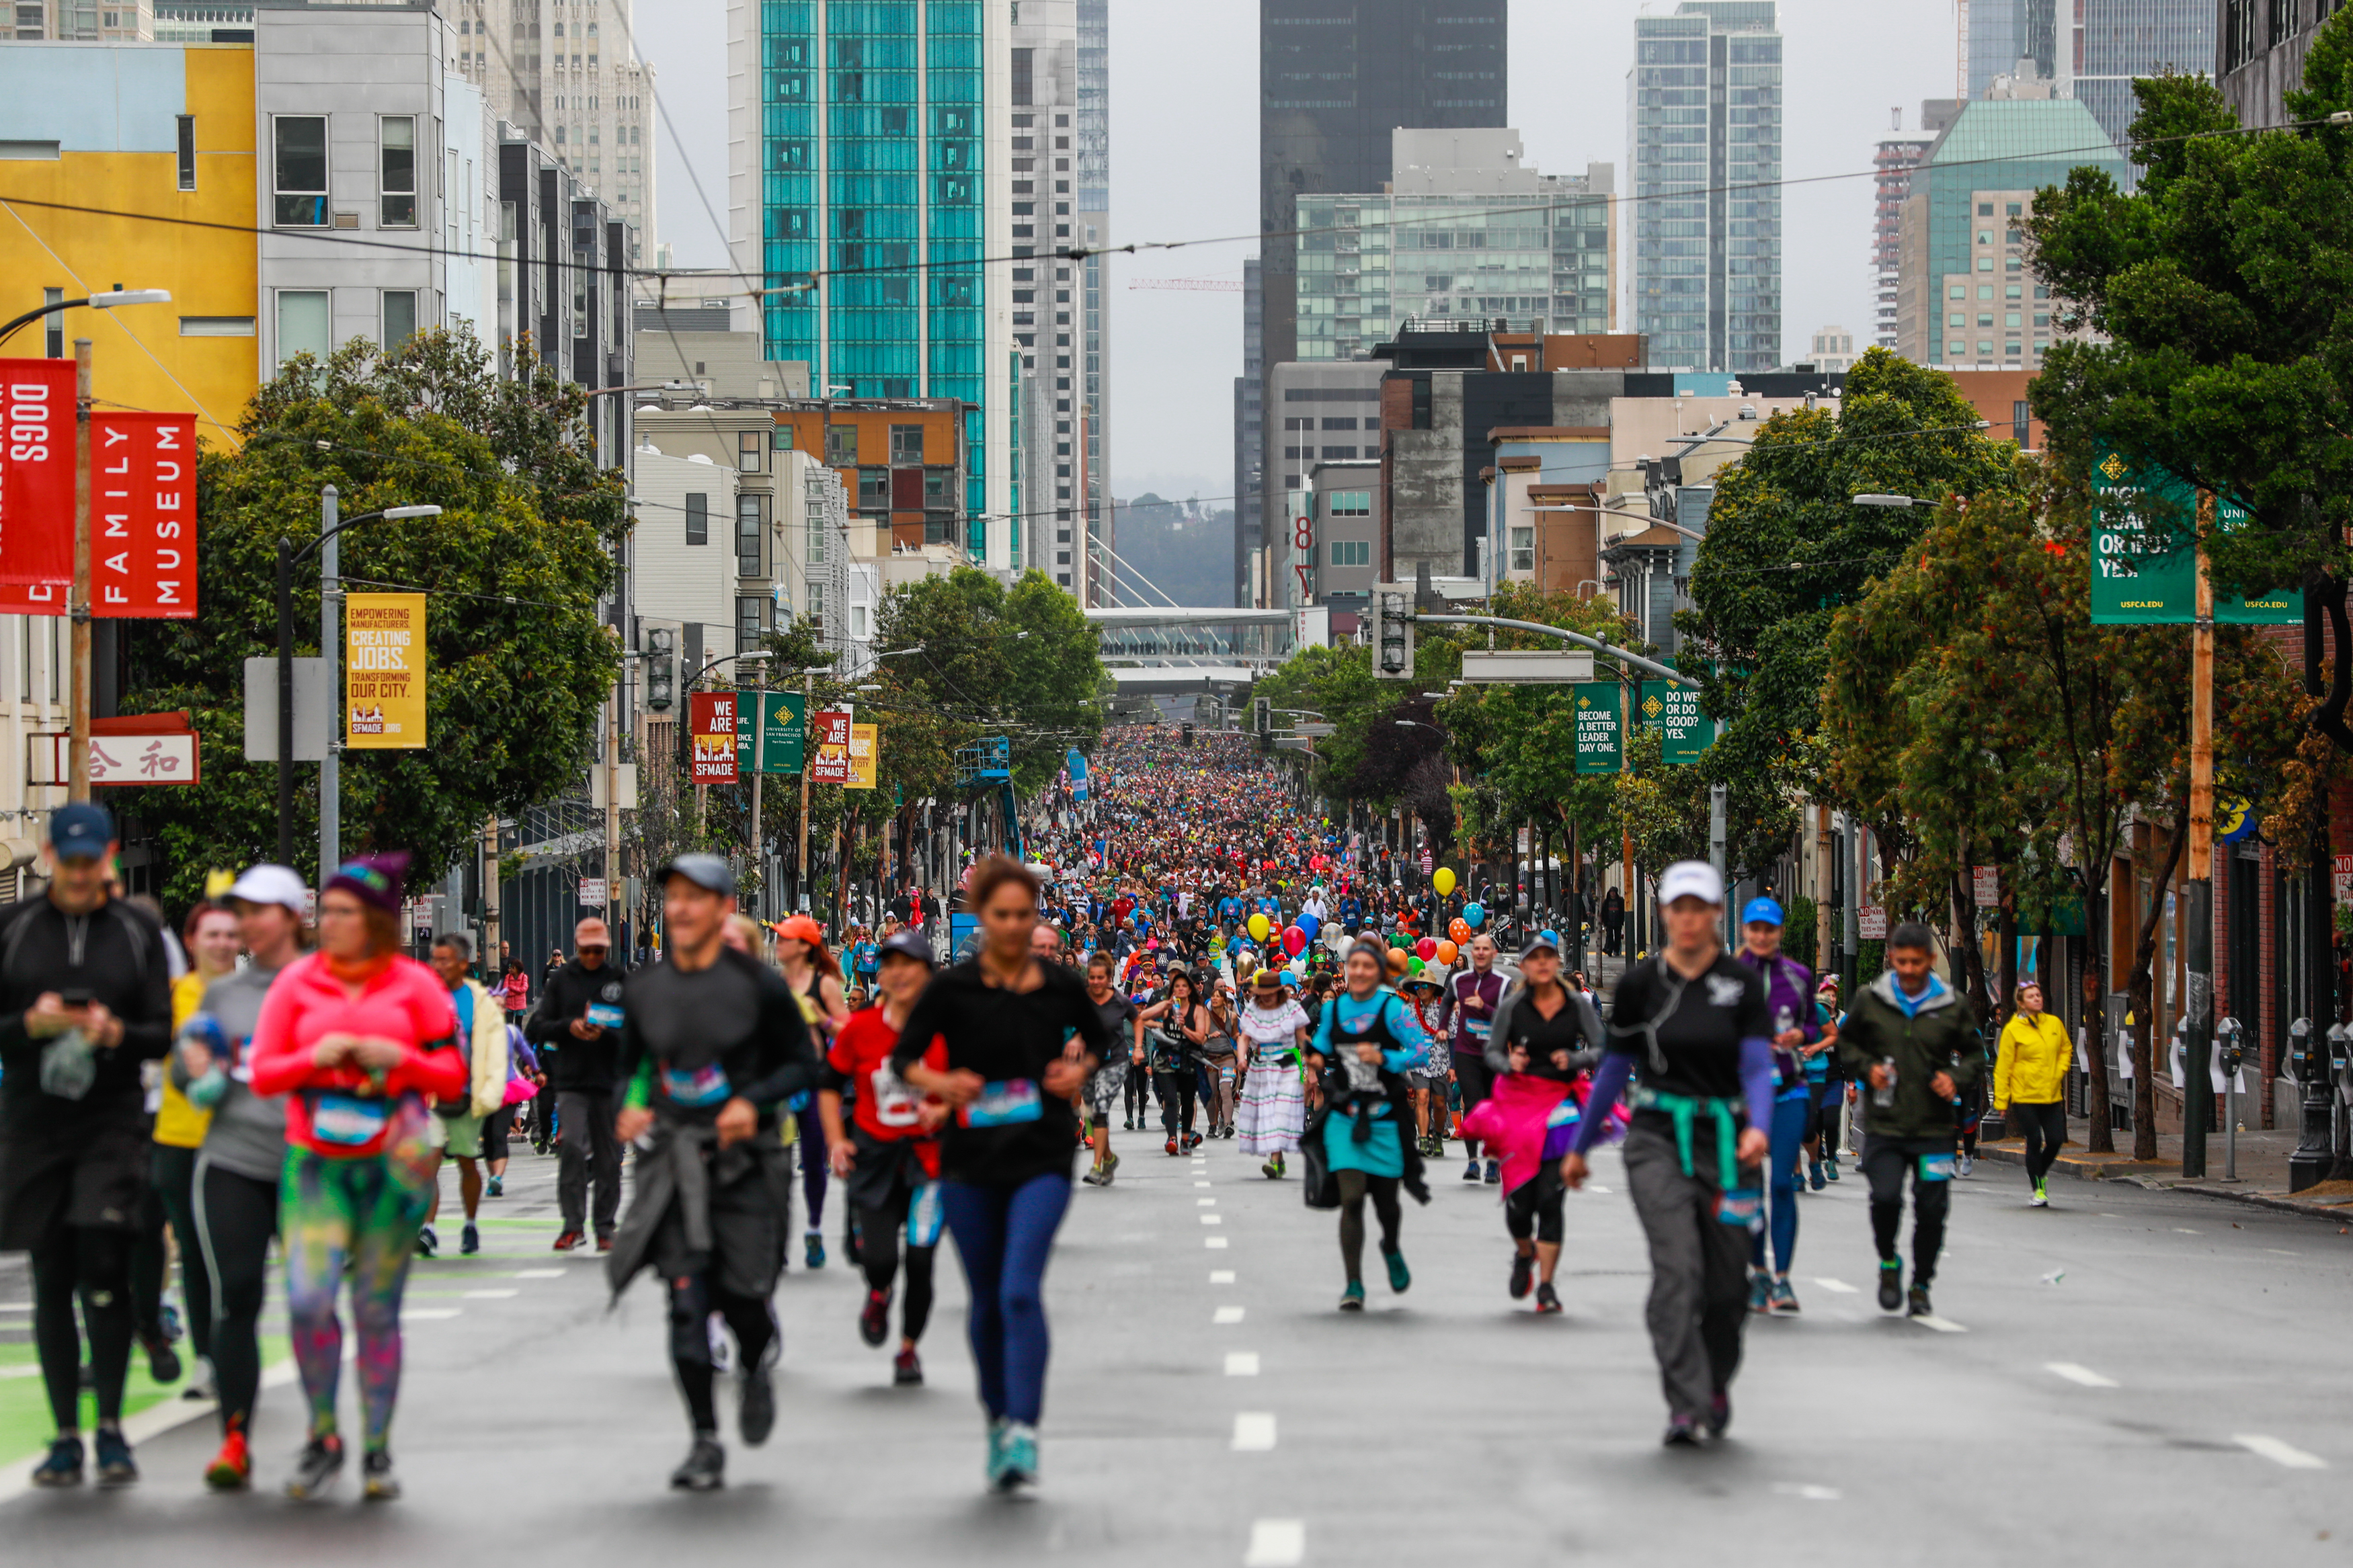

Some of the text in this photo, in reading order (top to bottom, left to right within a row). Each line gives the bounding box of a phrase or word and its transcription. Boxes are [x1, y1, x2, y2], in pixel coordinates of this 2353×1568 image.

[10, 384, 49, 462] DOGS
[105, 426, 128, 603] FAMILY
[156, 426, 181, 604] MUSEUM
[2099, 534, 2126, 554] OR
[350, 608, 409, 619] EMPOWERING
[350, 620, 410, 628] MANUFACTURERS.
[351, 630, 411, 646] CREATING
[352, 647, 409, 670] JOBS.
[350, 672, 410, 682] TRANSFORMING
[351, 683, 410, 698] OUR CITY.
[1666, 692, 1681, 702] DO
[714, 701, 732, 716] WE
[1666, 704, 1696, 714] OR DO
[1578, 711, 1611, 720] BECOME
[709, 717, 733, 732] ARE
[832, 718, 846, 731] WE
[1578, 722, 1616, 731] A BETTER
[1666, 716, 1699, 727] GOOD?
[828, 731, 846, 743] ARE
[1579, 733, 1609, 742] LEADER
[1666, 729, 1686, 739] YES.
[851, 746, 869, 756] OBS.
[1579, 743, 1617, 753] DAY ONE.
[696, 764, 733, 776] SFMADE
[815, 766, 845, 777] SFMADE
[2336, 857, 2351, 872] NO
[1860, 907, 1869, 916] NO
